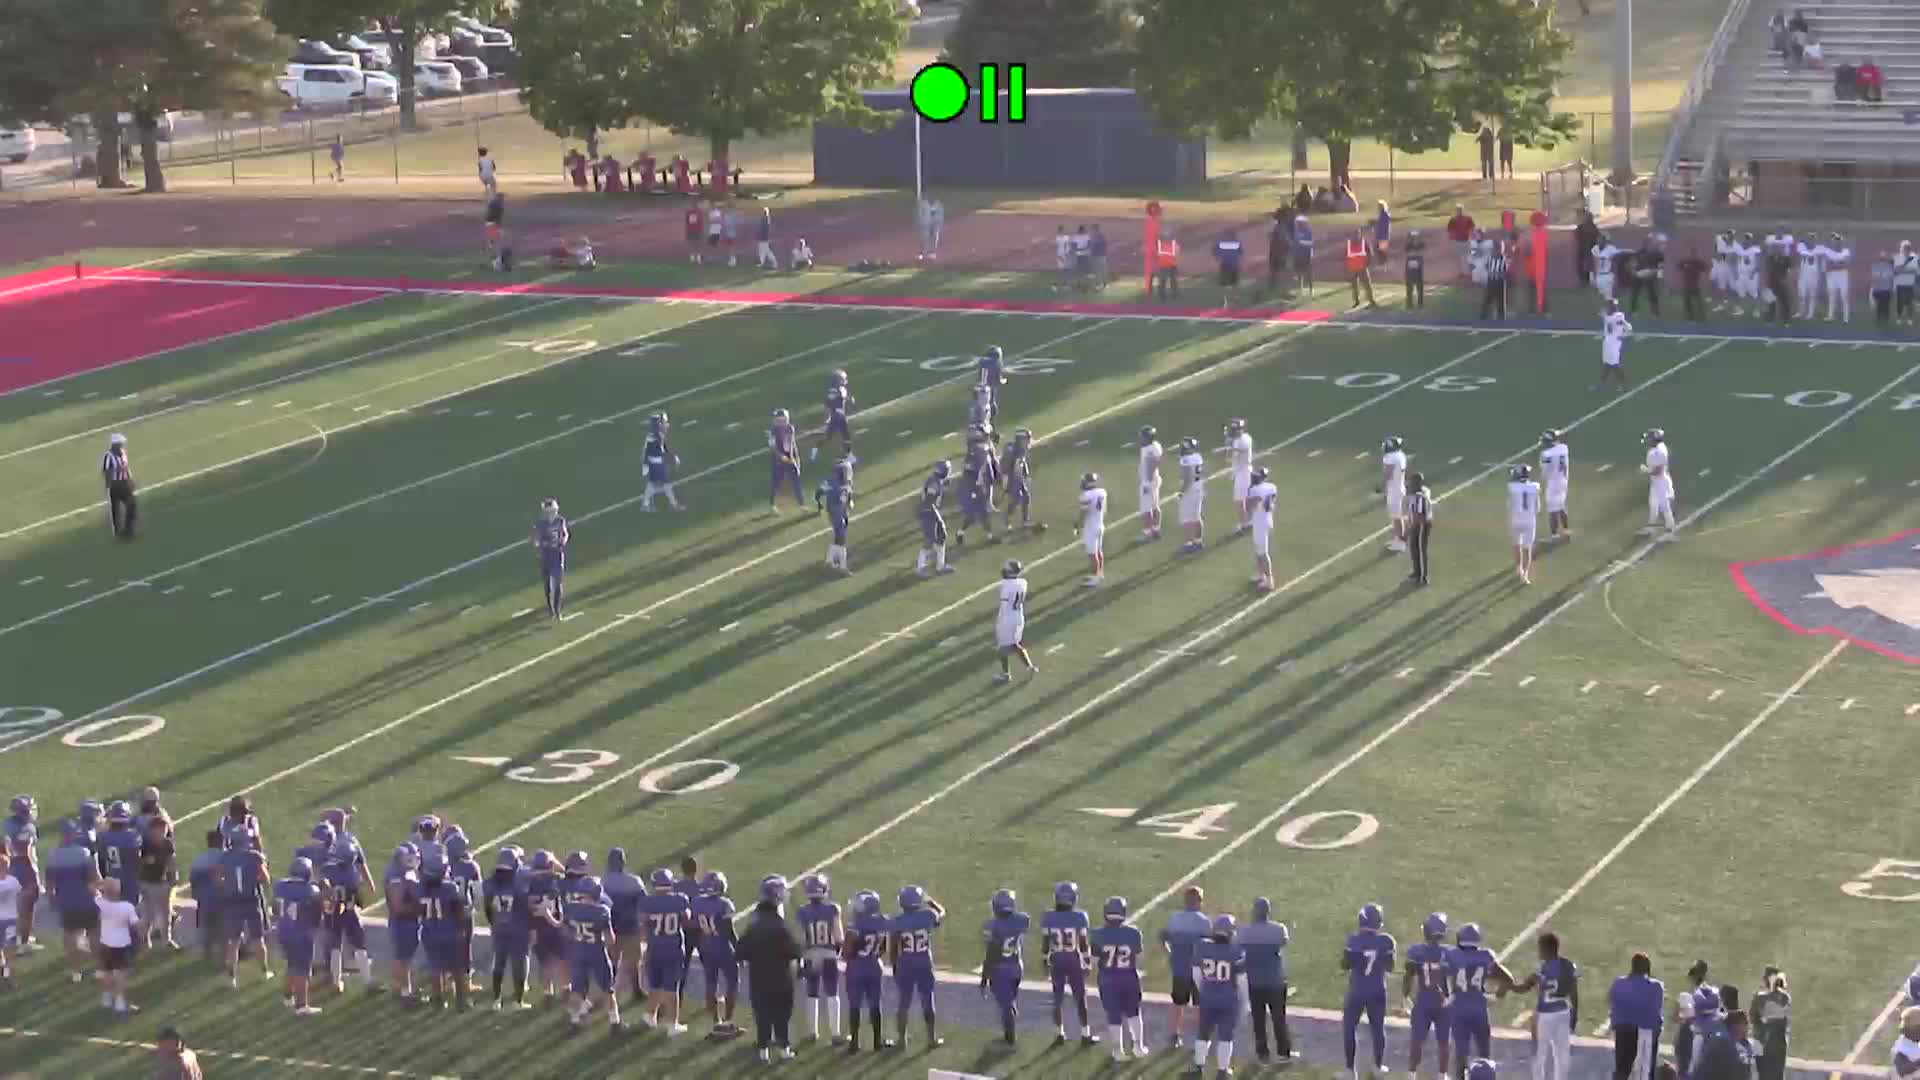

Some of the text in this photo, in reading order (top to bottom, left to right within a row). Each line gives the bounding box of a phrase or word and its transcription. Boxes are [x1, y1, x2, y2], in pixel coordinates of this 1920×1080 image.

[505, 749, 740, 794] 30
[1136, 801, 1380, 849] 40
[649, 912, 679, 937] 70
[900, 928, 928, 953] 32
[1049, 927, 1077, 953] 33
[1103, 945, 1131, 969] 72
[1202, 958, 1231, 981] 20
[1363, 950, 1377, 977] 7
[1455, 966, 1485, 993] 44
